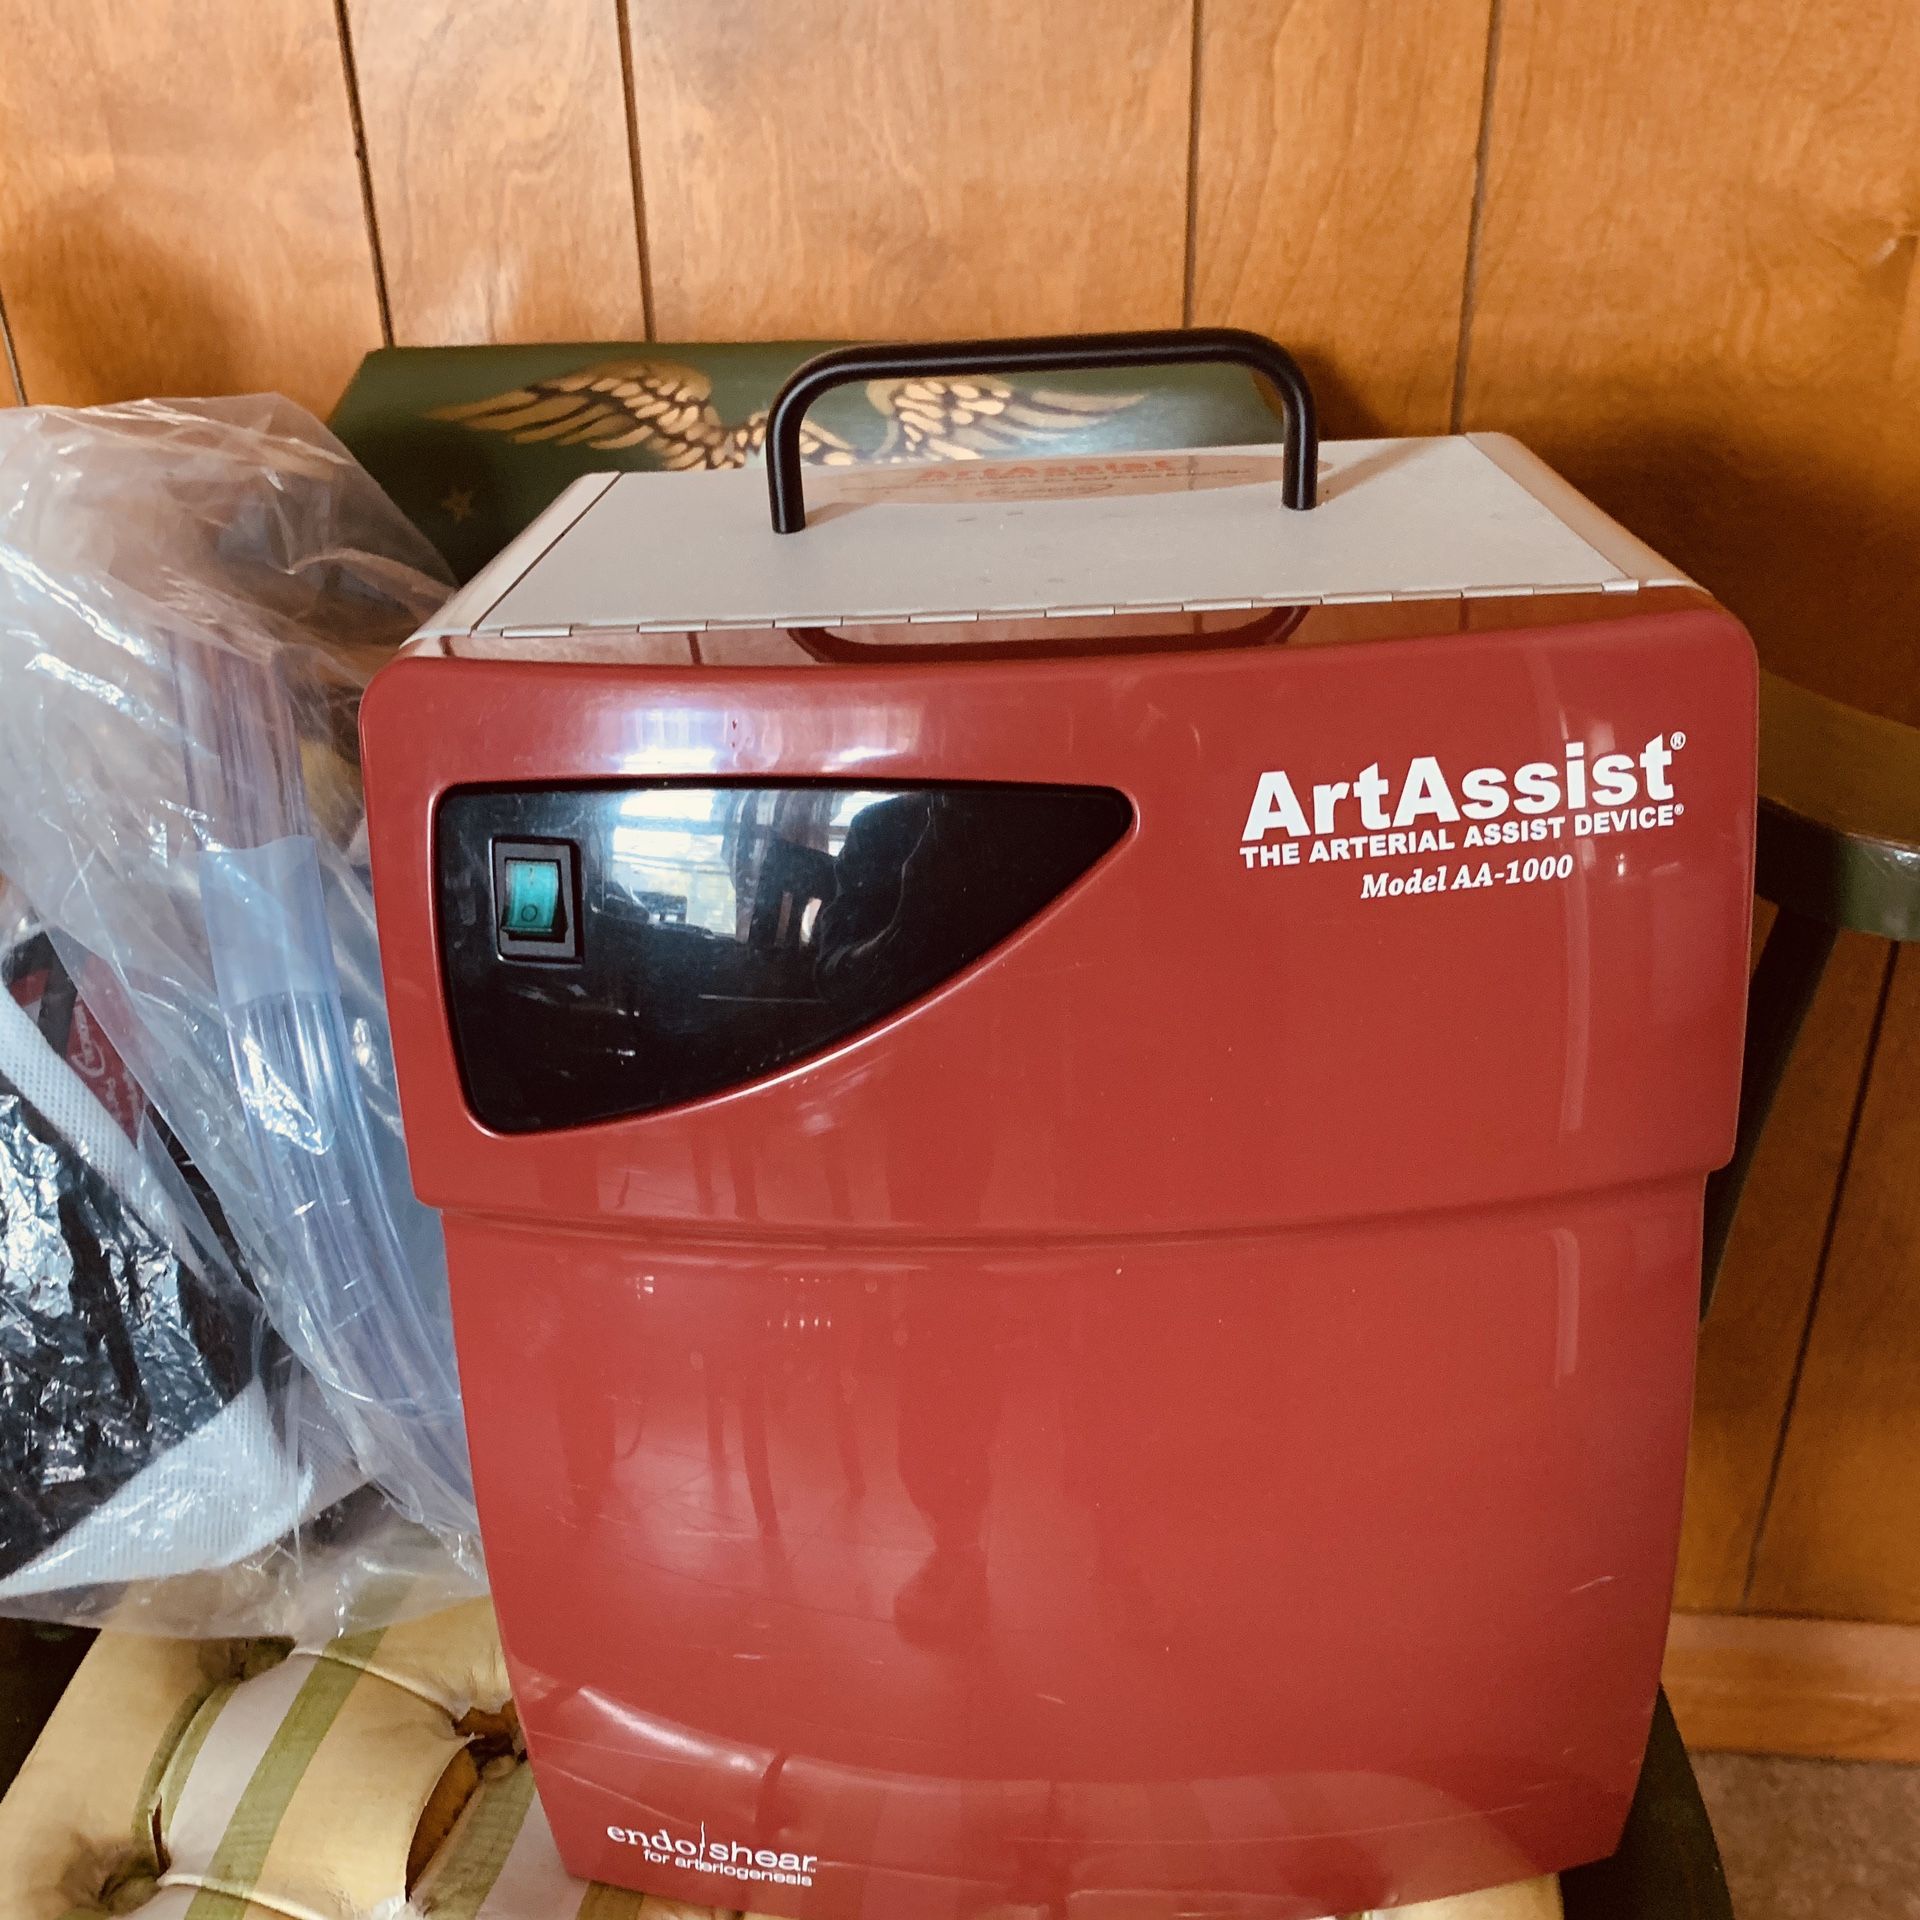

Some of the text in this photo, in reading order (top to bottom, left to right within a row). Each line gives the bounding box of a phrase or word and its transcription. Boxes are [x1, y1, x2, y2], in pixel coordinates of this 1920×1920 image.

[1239, 842, 1301, 869] THE
[1308, 828, 1456, 864] ARTERIAL
[1463, 816, 1566, 849] ASSIST
[1360, 854, 1574, 899] Model AA-1000
[643, 1848, 813, 1887] for arteriogenesis
